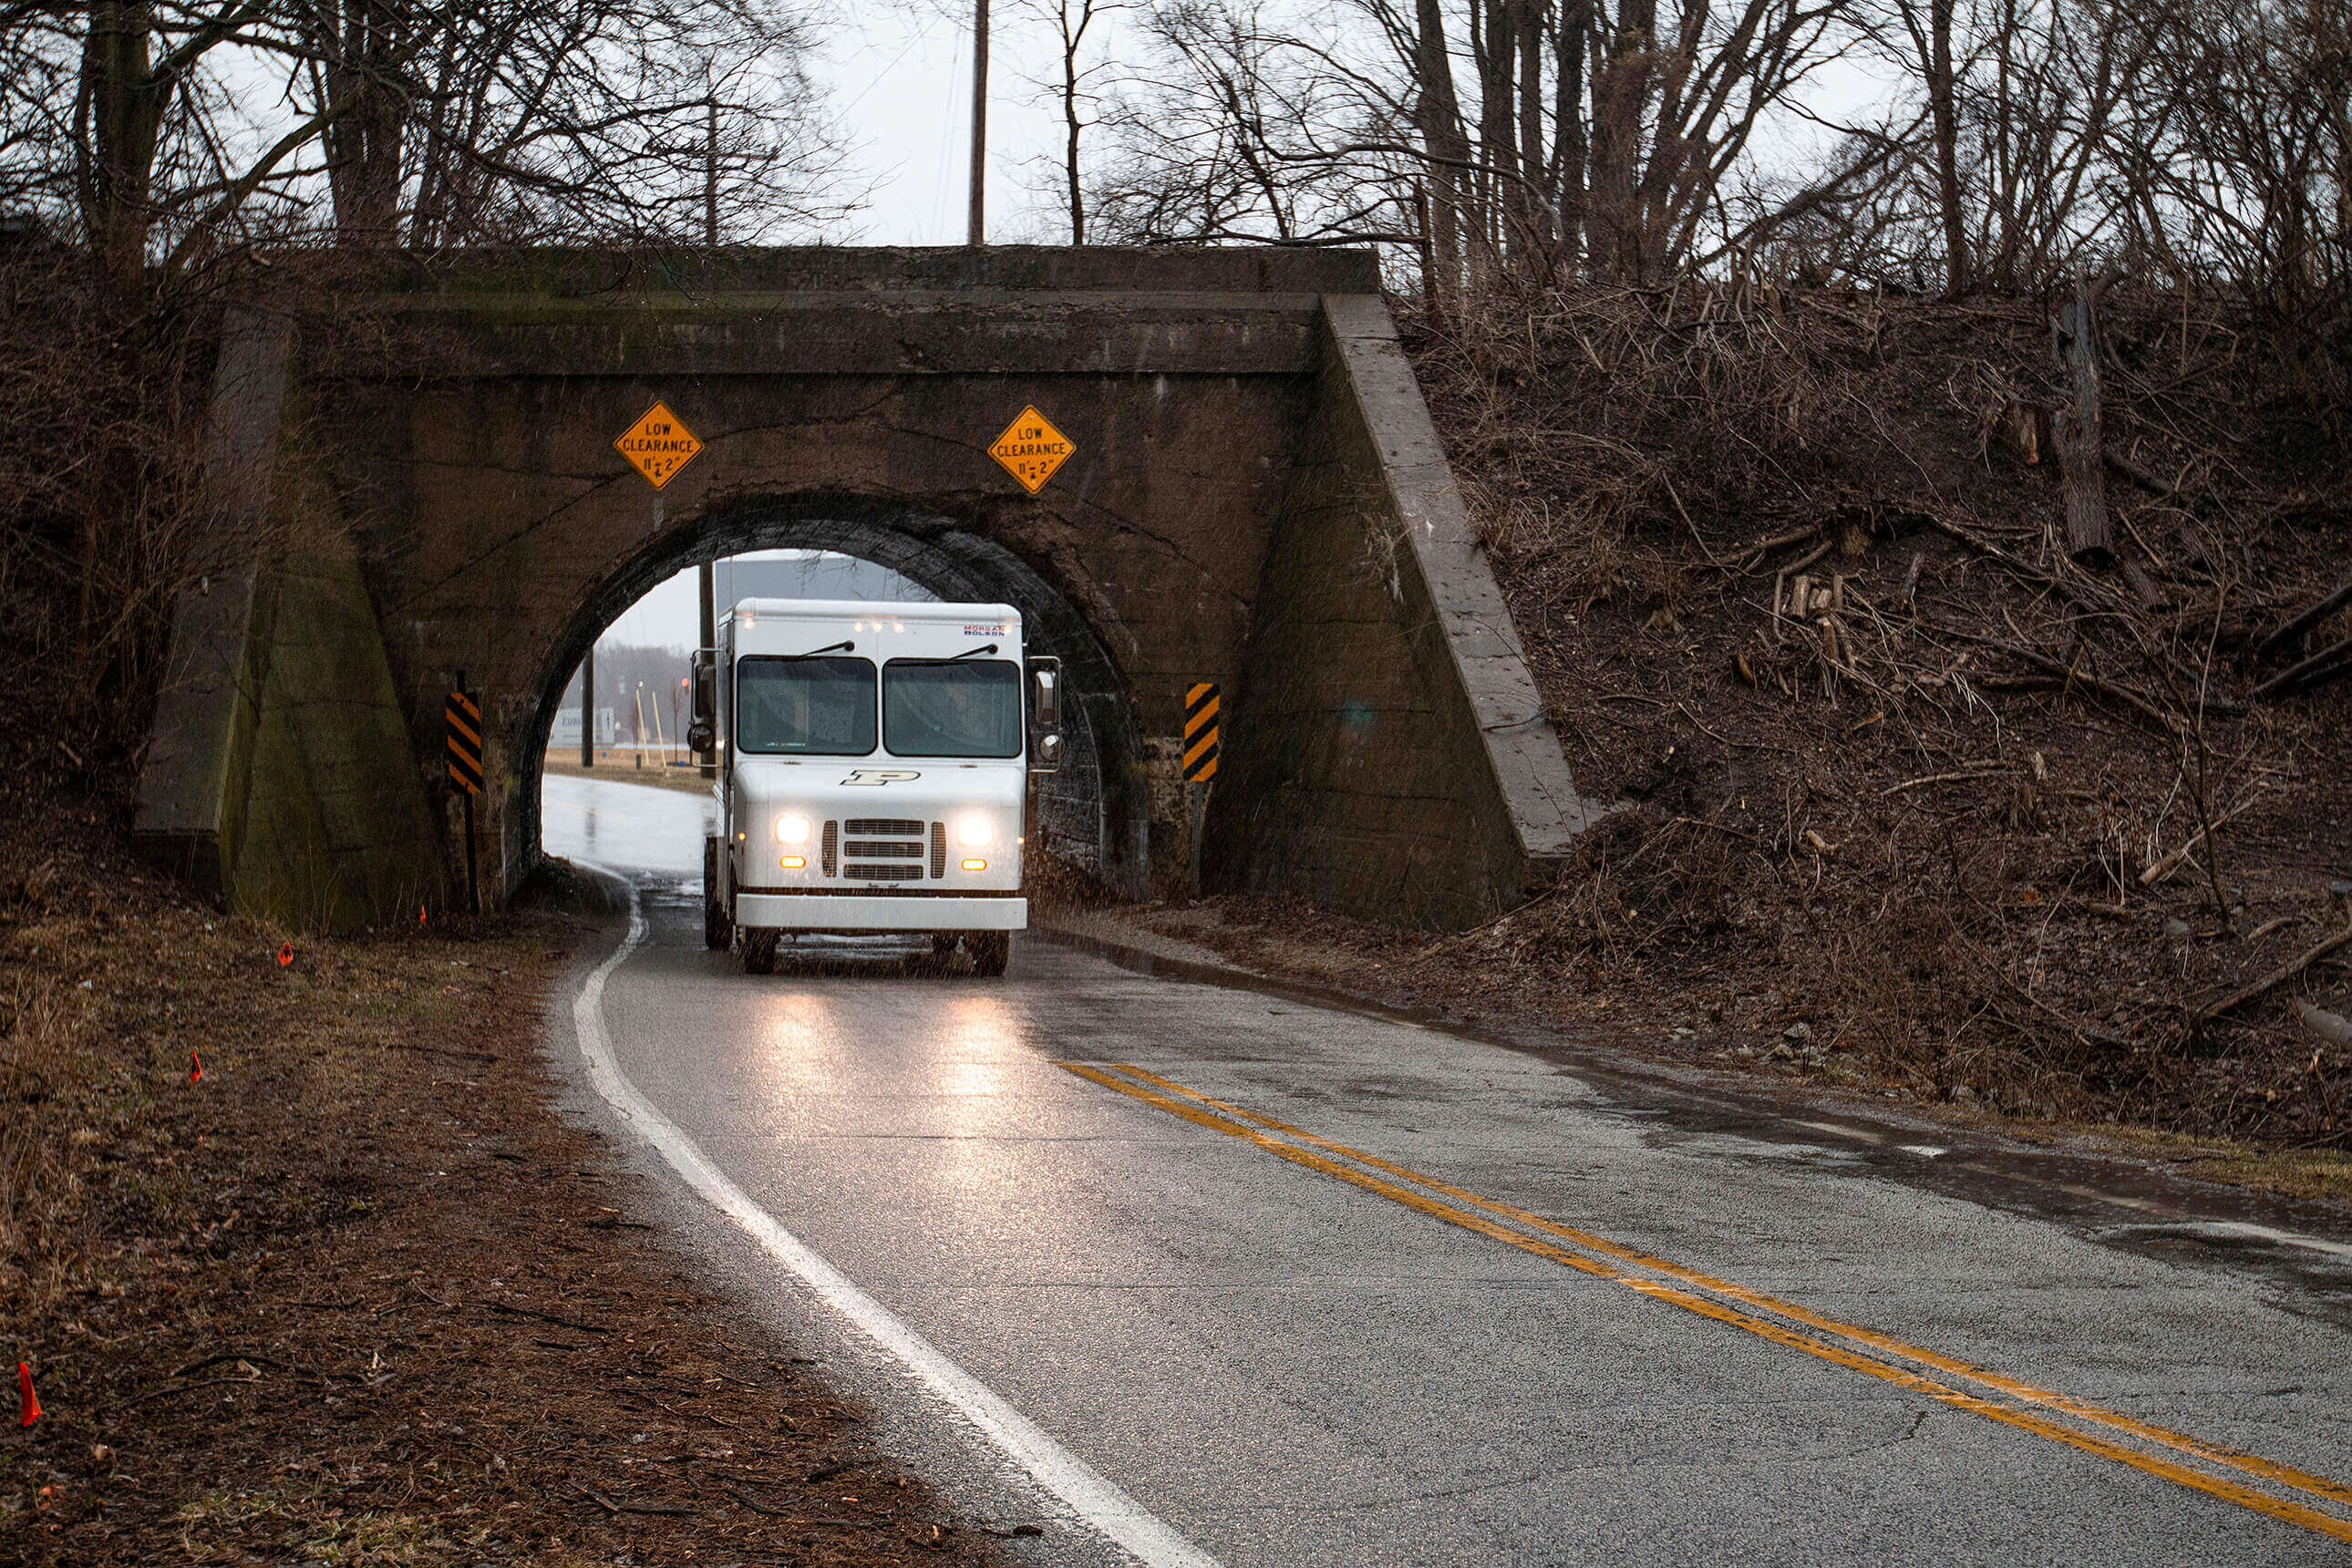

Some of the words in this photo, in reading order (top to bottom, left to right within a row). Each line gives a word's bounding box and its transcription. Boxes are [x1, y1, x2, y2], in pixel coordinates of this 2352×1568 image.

[645, 423, 671, 436] LOW
[1017, 428, 1043, 440] LOW
[622, 438, 693, 452] CLEARANCE
[996, 442, 1066, 458] CLEARANCE
[839, 769, 921, 786] P
